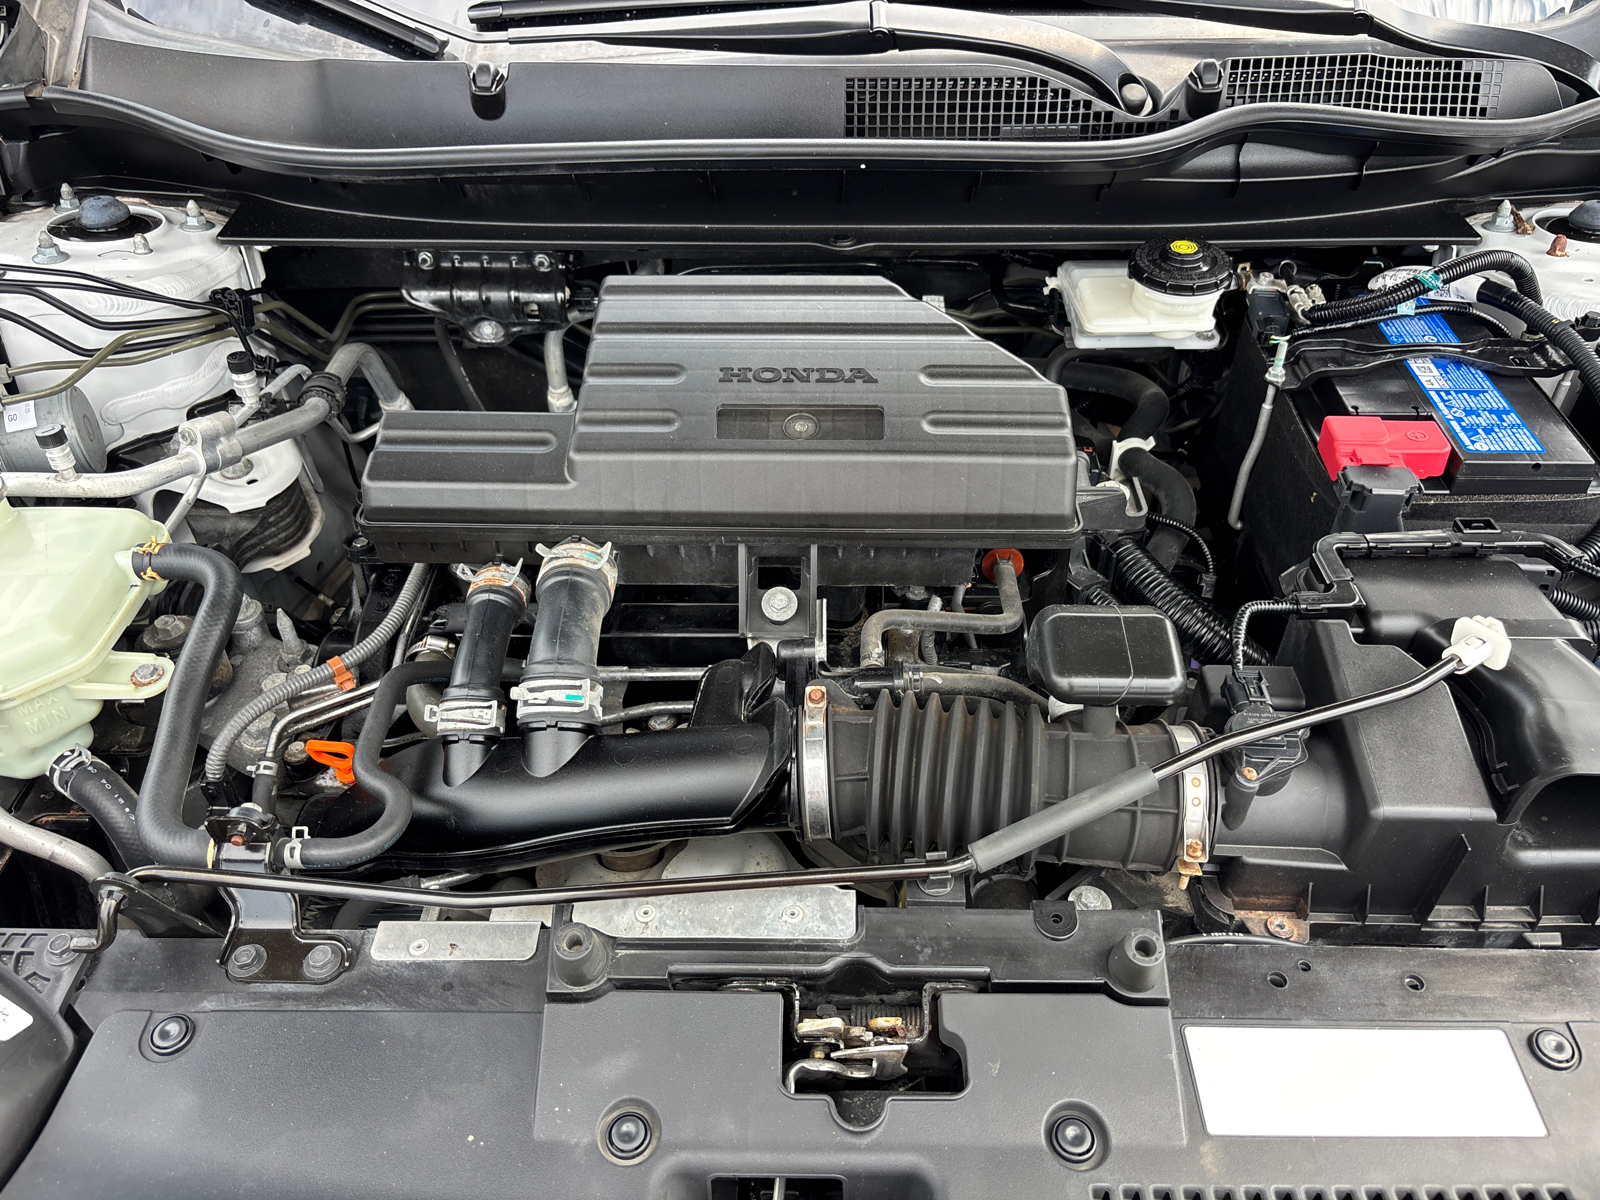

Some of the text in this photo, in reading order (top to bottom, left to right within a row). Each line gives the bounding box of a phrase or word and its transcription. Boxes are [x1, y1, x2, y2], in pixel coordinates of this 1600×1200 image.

[718, 367, 879, 384] HONDA
[18, 691, 60, 717] MAX
[24, 705, 70, 735] MIN
